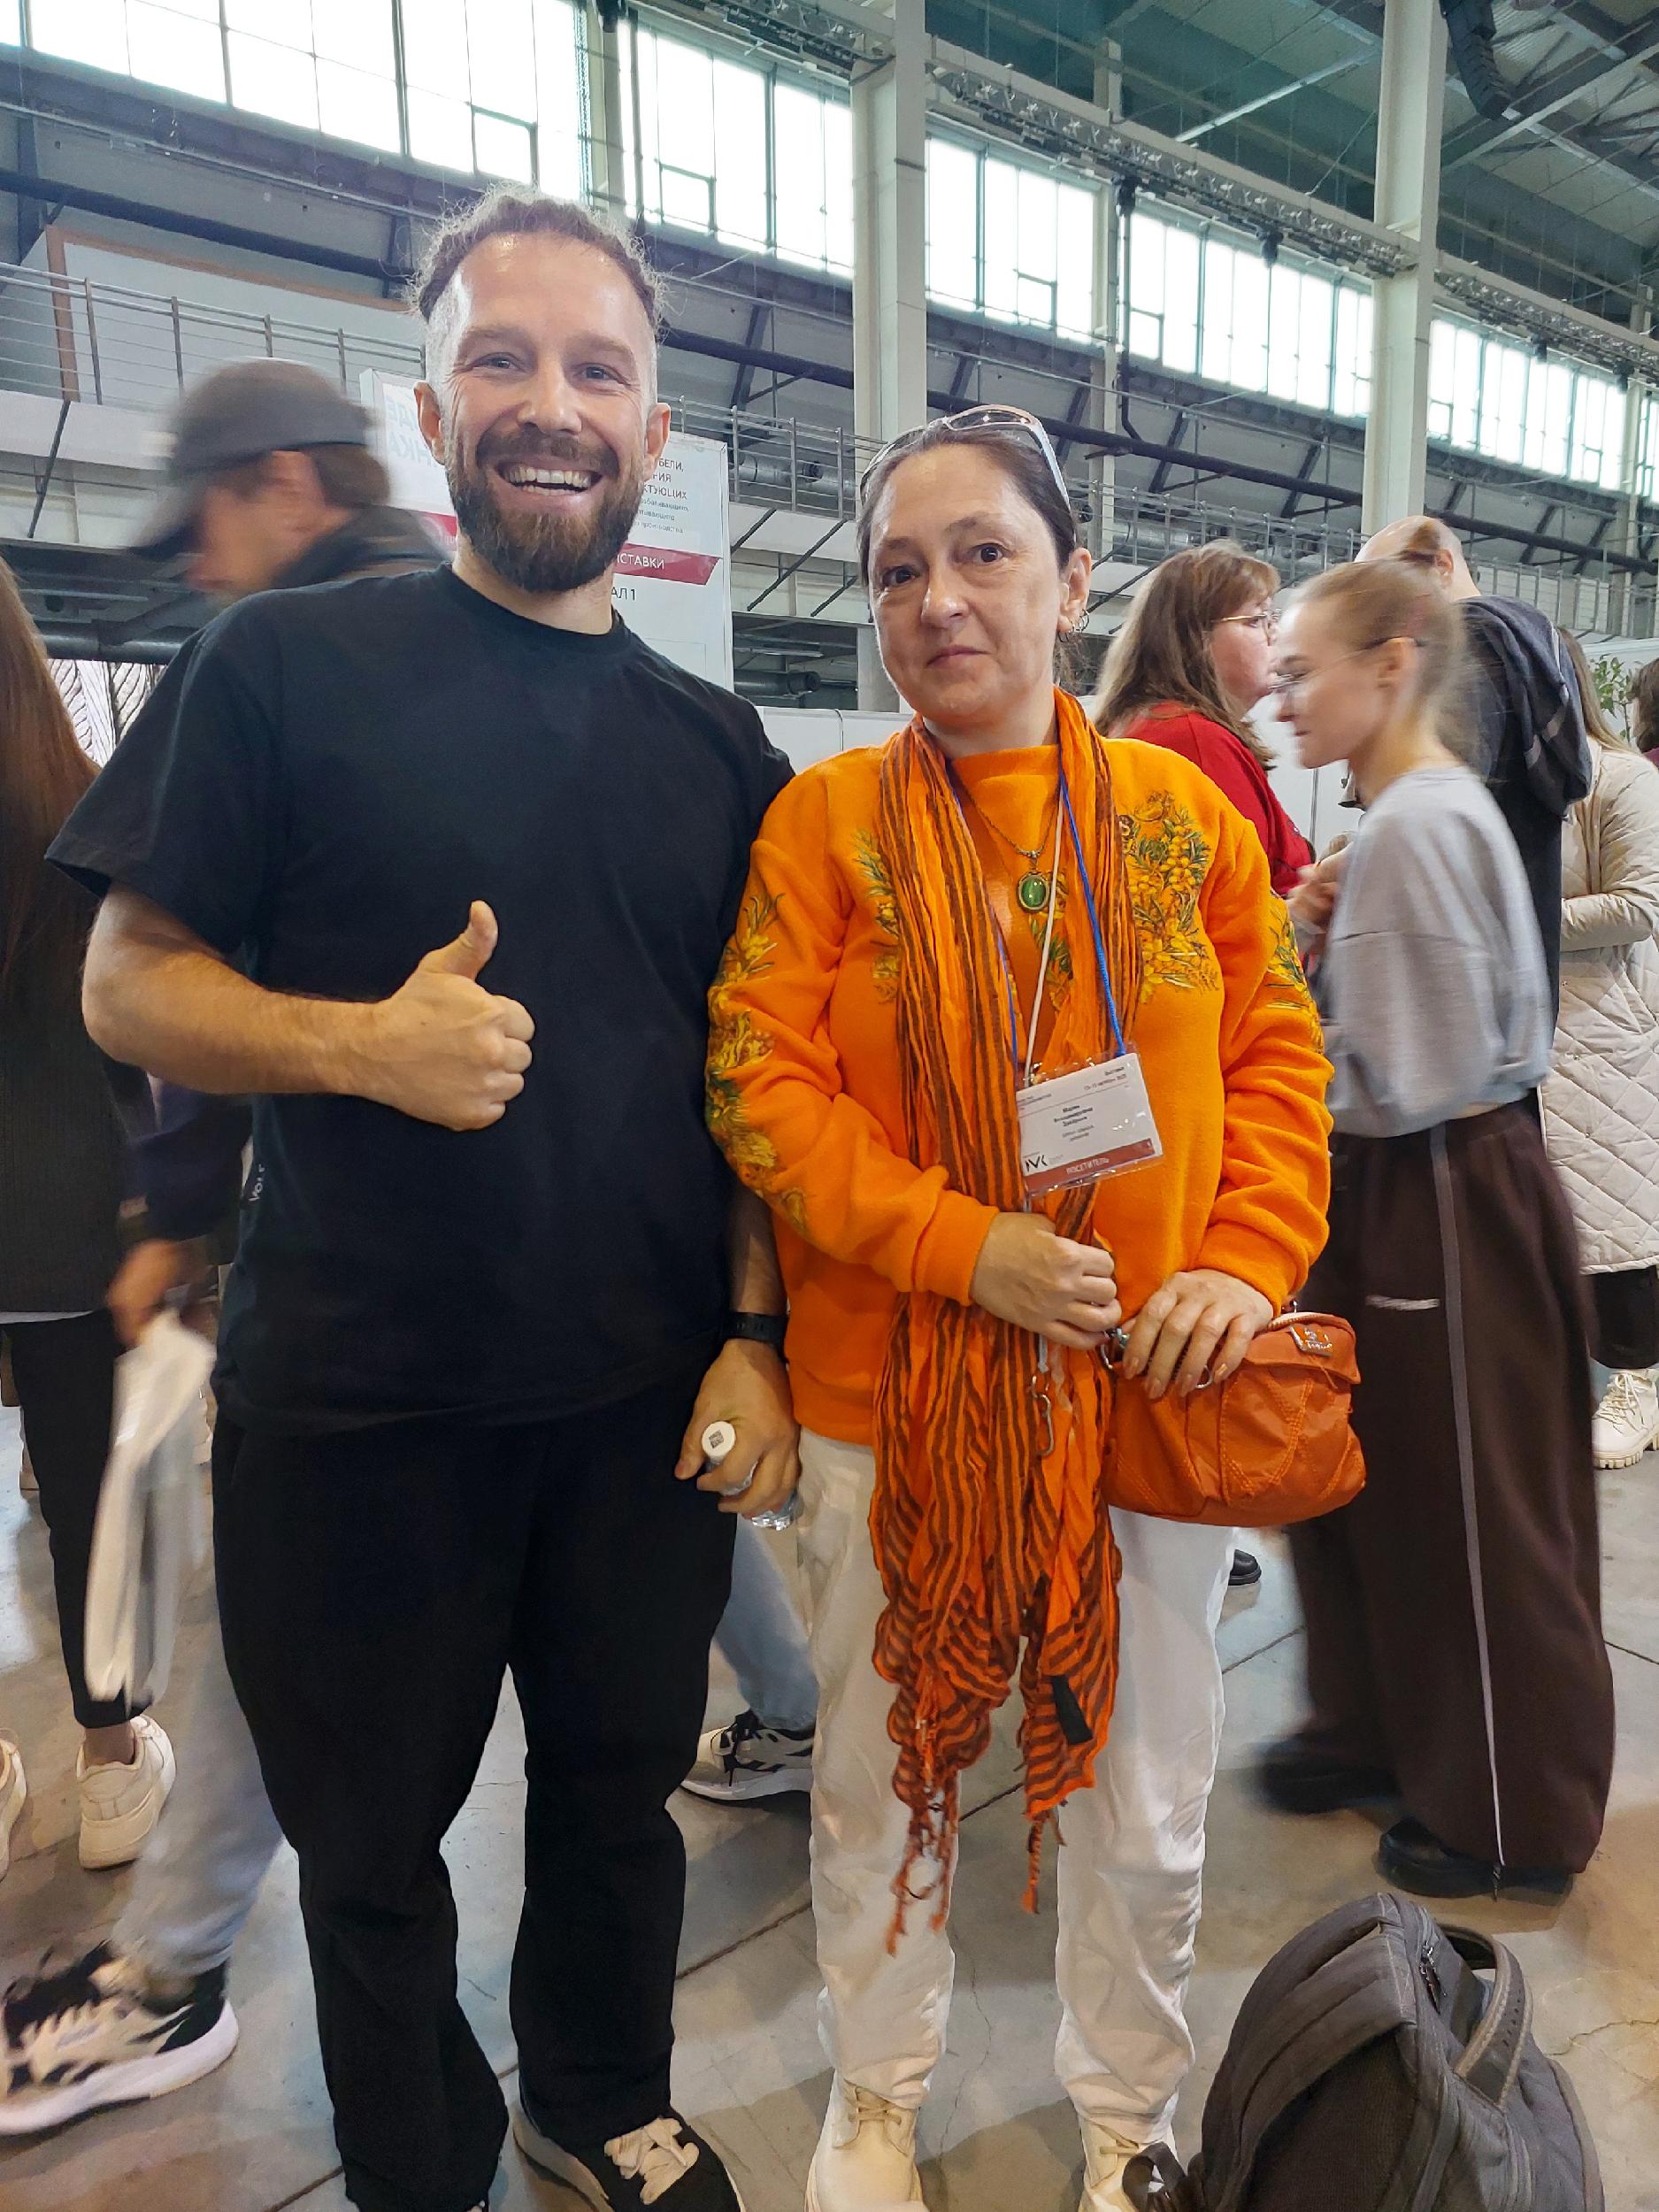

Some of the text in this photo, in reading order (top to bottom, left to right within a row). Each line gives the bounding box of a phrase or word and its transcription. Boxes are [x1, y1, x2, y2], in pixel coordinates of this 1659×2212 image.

[658, 458, 684, 472] БЕЛИ,
[653, 472, 672, 483] НИЯ
[643, 484, 687, 500] КТУЮЩИХ
[617, 553, 664, 569] СТАВКИ
[611, 586, 636, 601] АЛ 1
